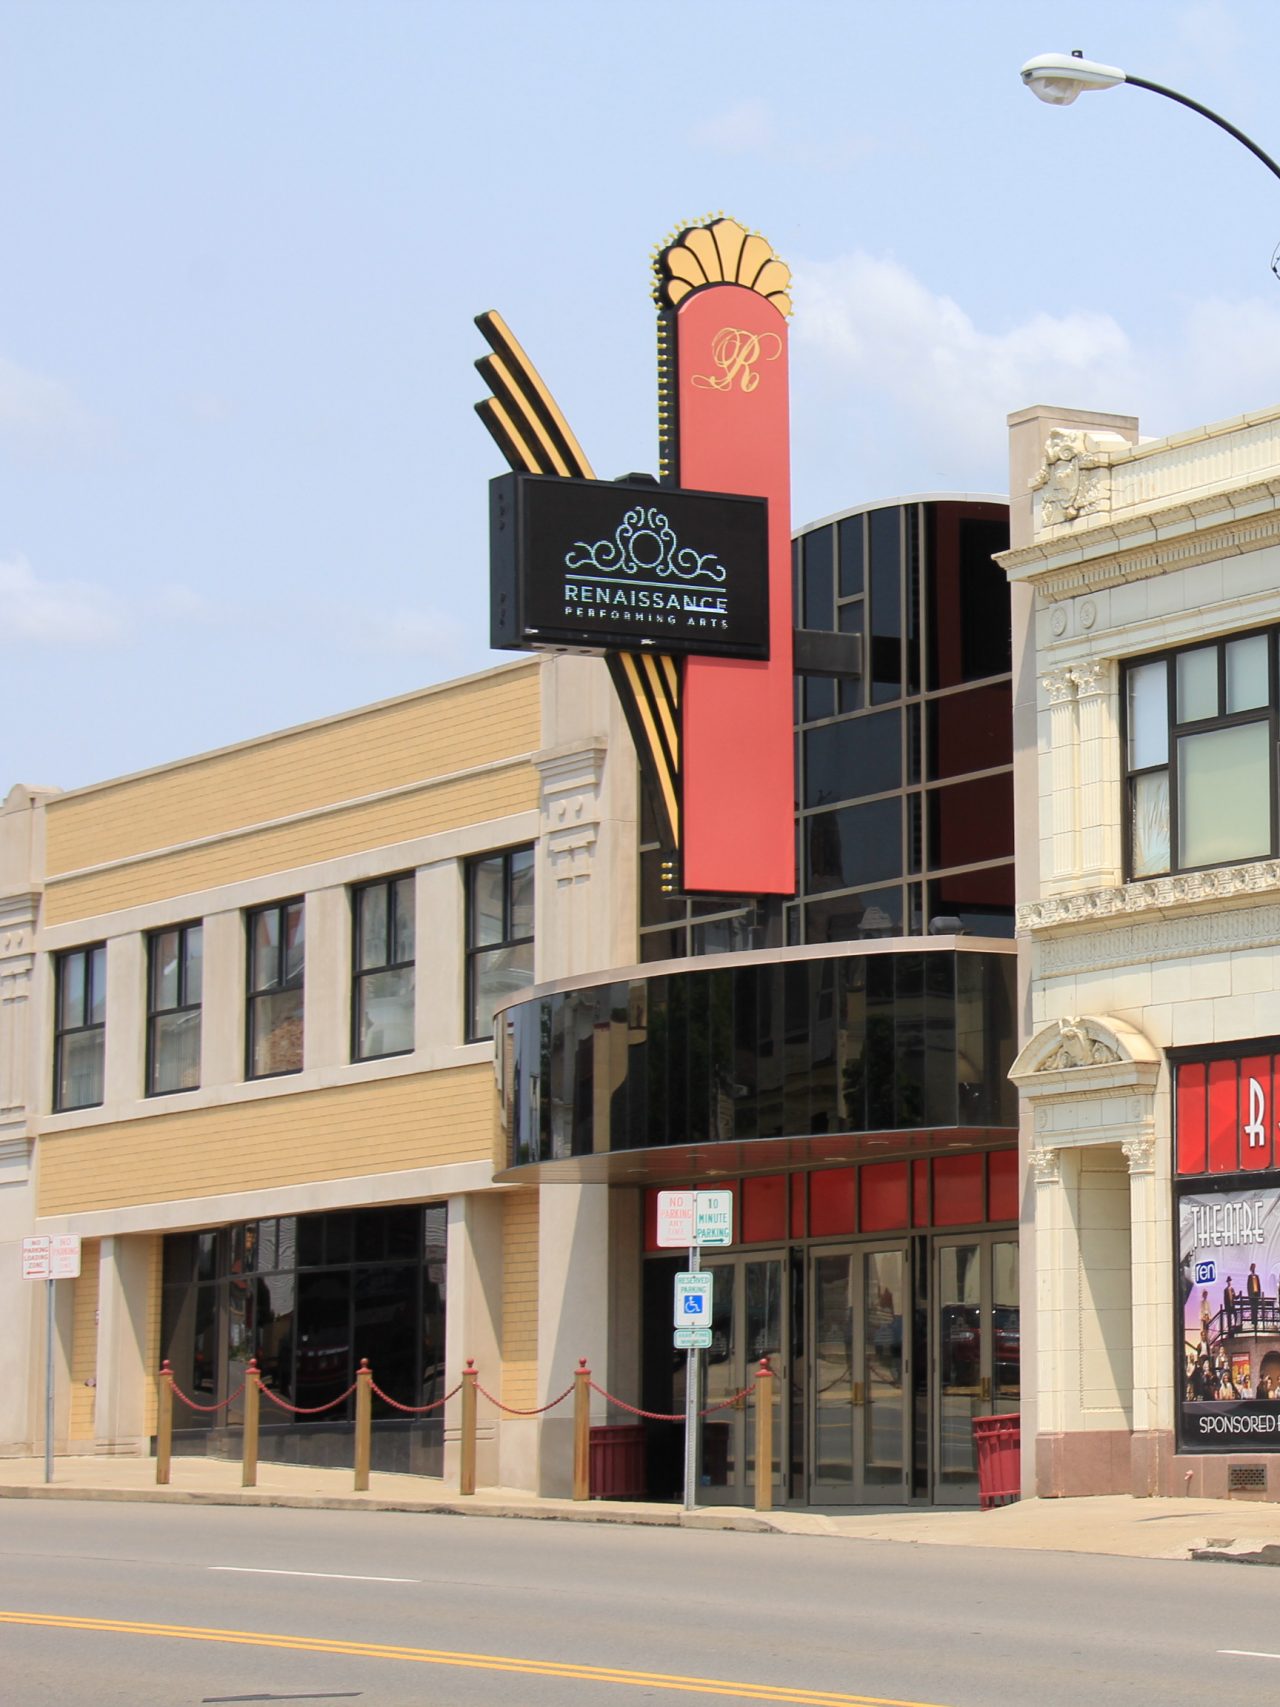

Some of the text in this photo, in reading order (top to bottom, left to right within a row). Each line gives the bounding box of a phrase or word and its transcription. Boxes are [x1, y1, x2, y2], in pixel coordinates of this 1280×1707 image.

[564, 584, 728, 614] RENAISSANCE
[564, 606, 729, 630] PERFORMING ARTS
[670, 1196, 684, 1207] NO
[708, 1198, 719, 1209] 10
[661, 1209, 691, 1219] PARKING
[698, 1213, 728, 1224] MINUTE
[1191, 1201, 1264, 1249] THEATRE
[697, 1228, 729, 1238] PARKING
[1196, 1263, 1215, 1282] ren
[1199, 1415, 1276, 1434] SPONSORED
